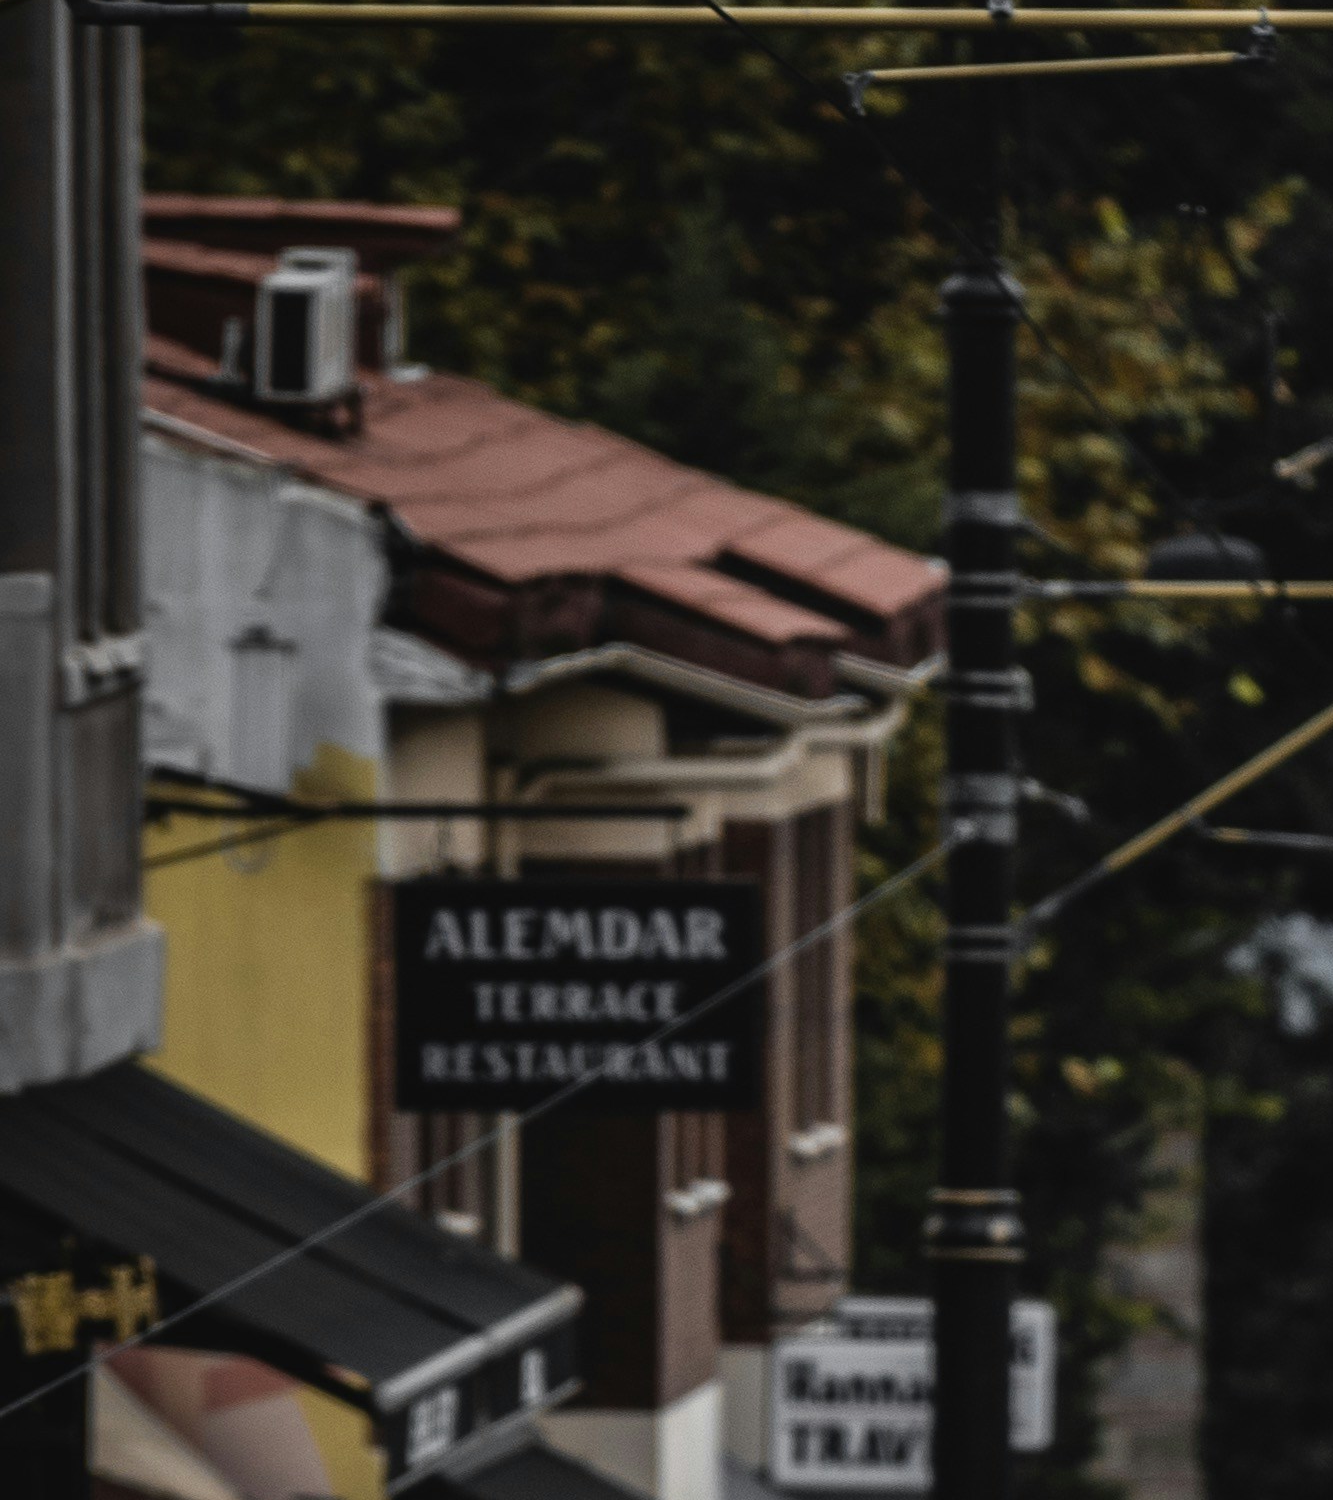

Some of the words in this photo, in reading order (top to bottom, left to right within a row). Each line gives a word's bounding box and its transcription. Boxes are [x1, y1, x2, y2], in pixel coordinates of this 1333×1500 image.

[422, 905, 729, 962] ALEMDAR
[472, 980, 687, 1023] TERRACE
[420, 1039, 732, 1084] RESTAURANT
